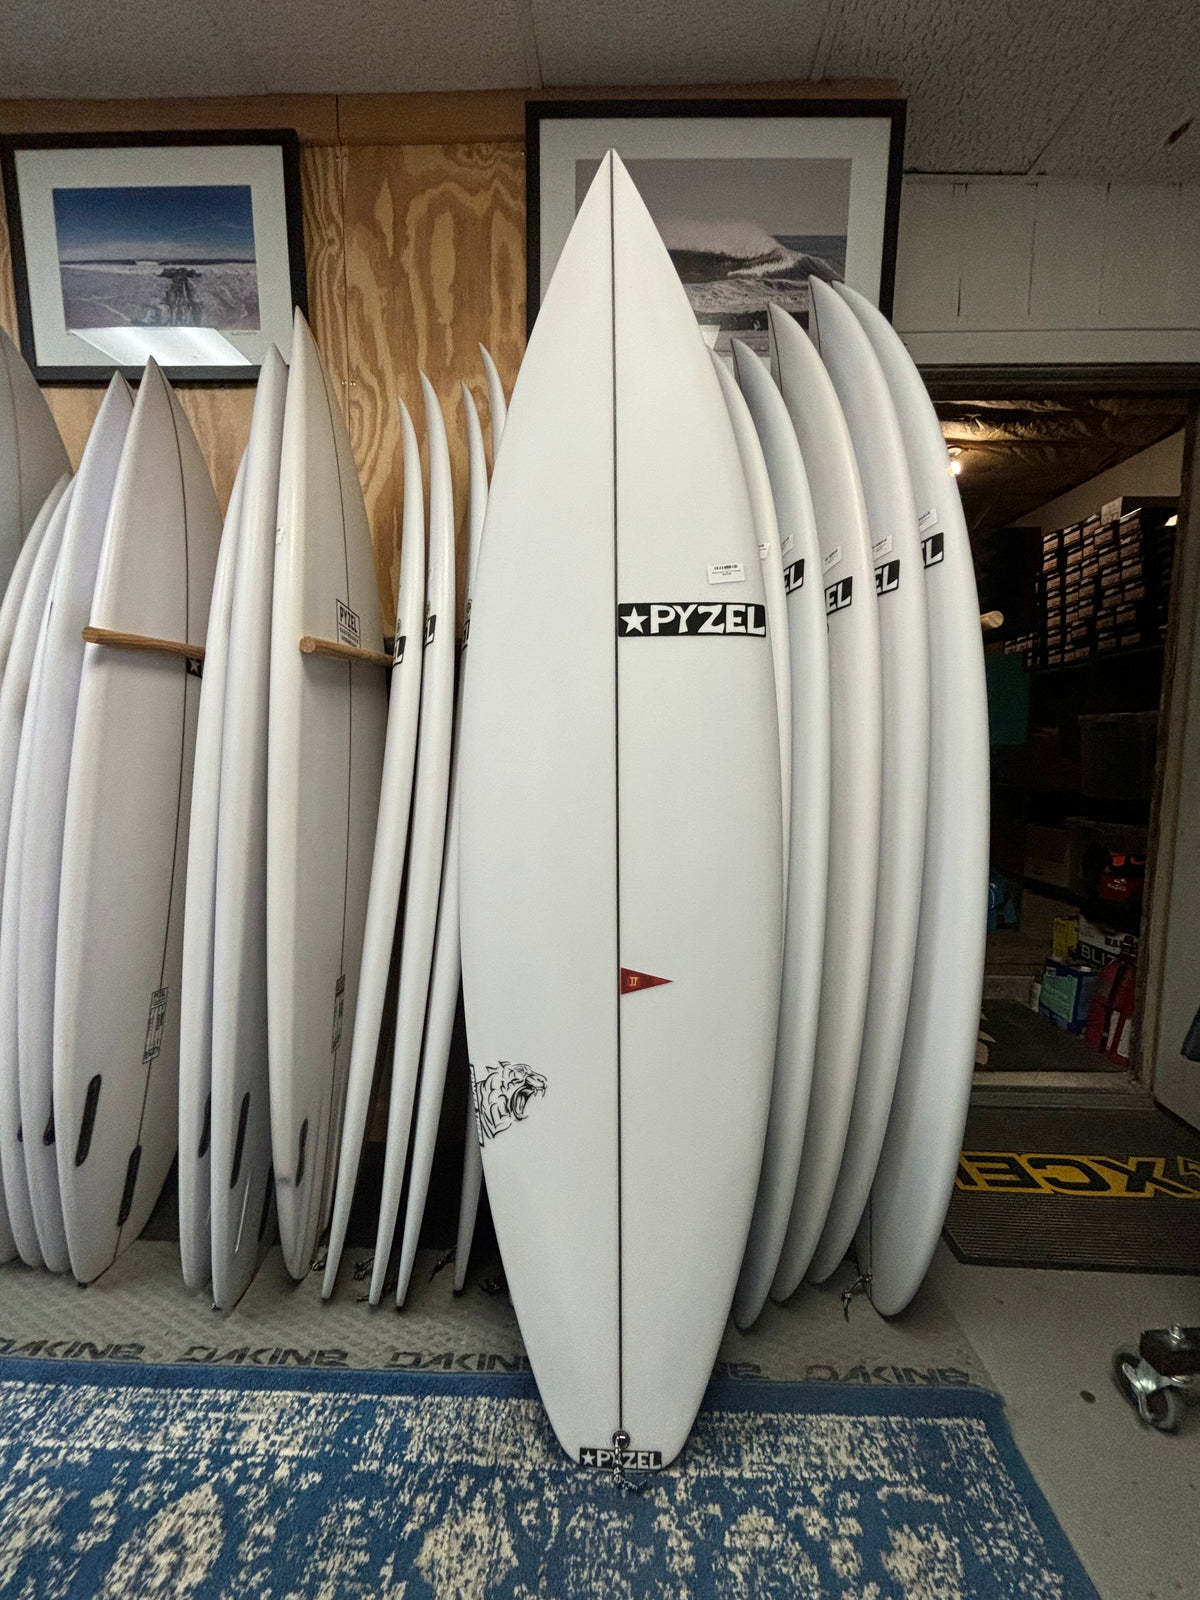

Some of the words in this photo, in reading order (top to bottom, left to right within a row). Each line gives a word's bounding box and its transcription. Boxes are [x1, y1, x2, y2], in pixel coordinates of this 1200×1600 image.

[340, 605, 358, 634] PYZEL
[650, 604, 765, 635] PYZEL
[174, 1345, 350, 1367] DAKINE
[805, 1364, 982, 1388] DAKINE
